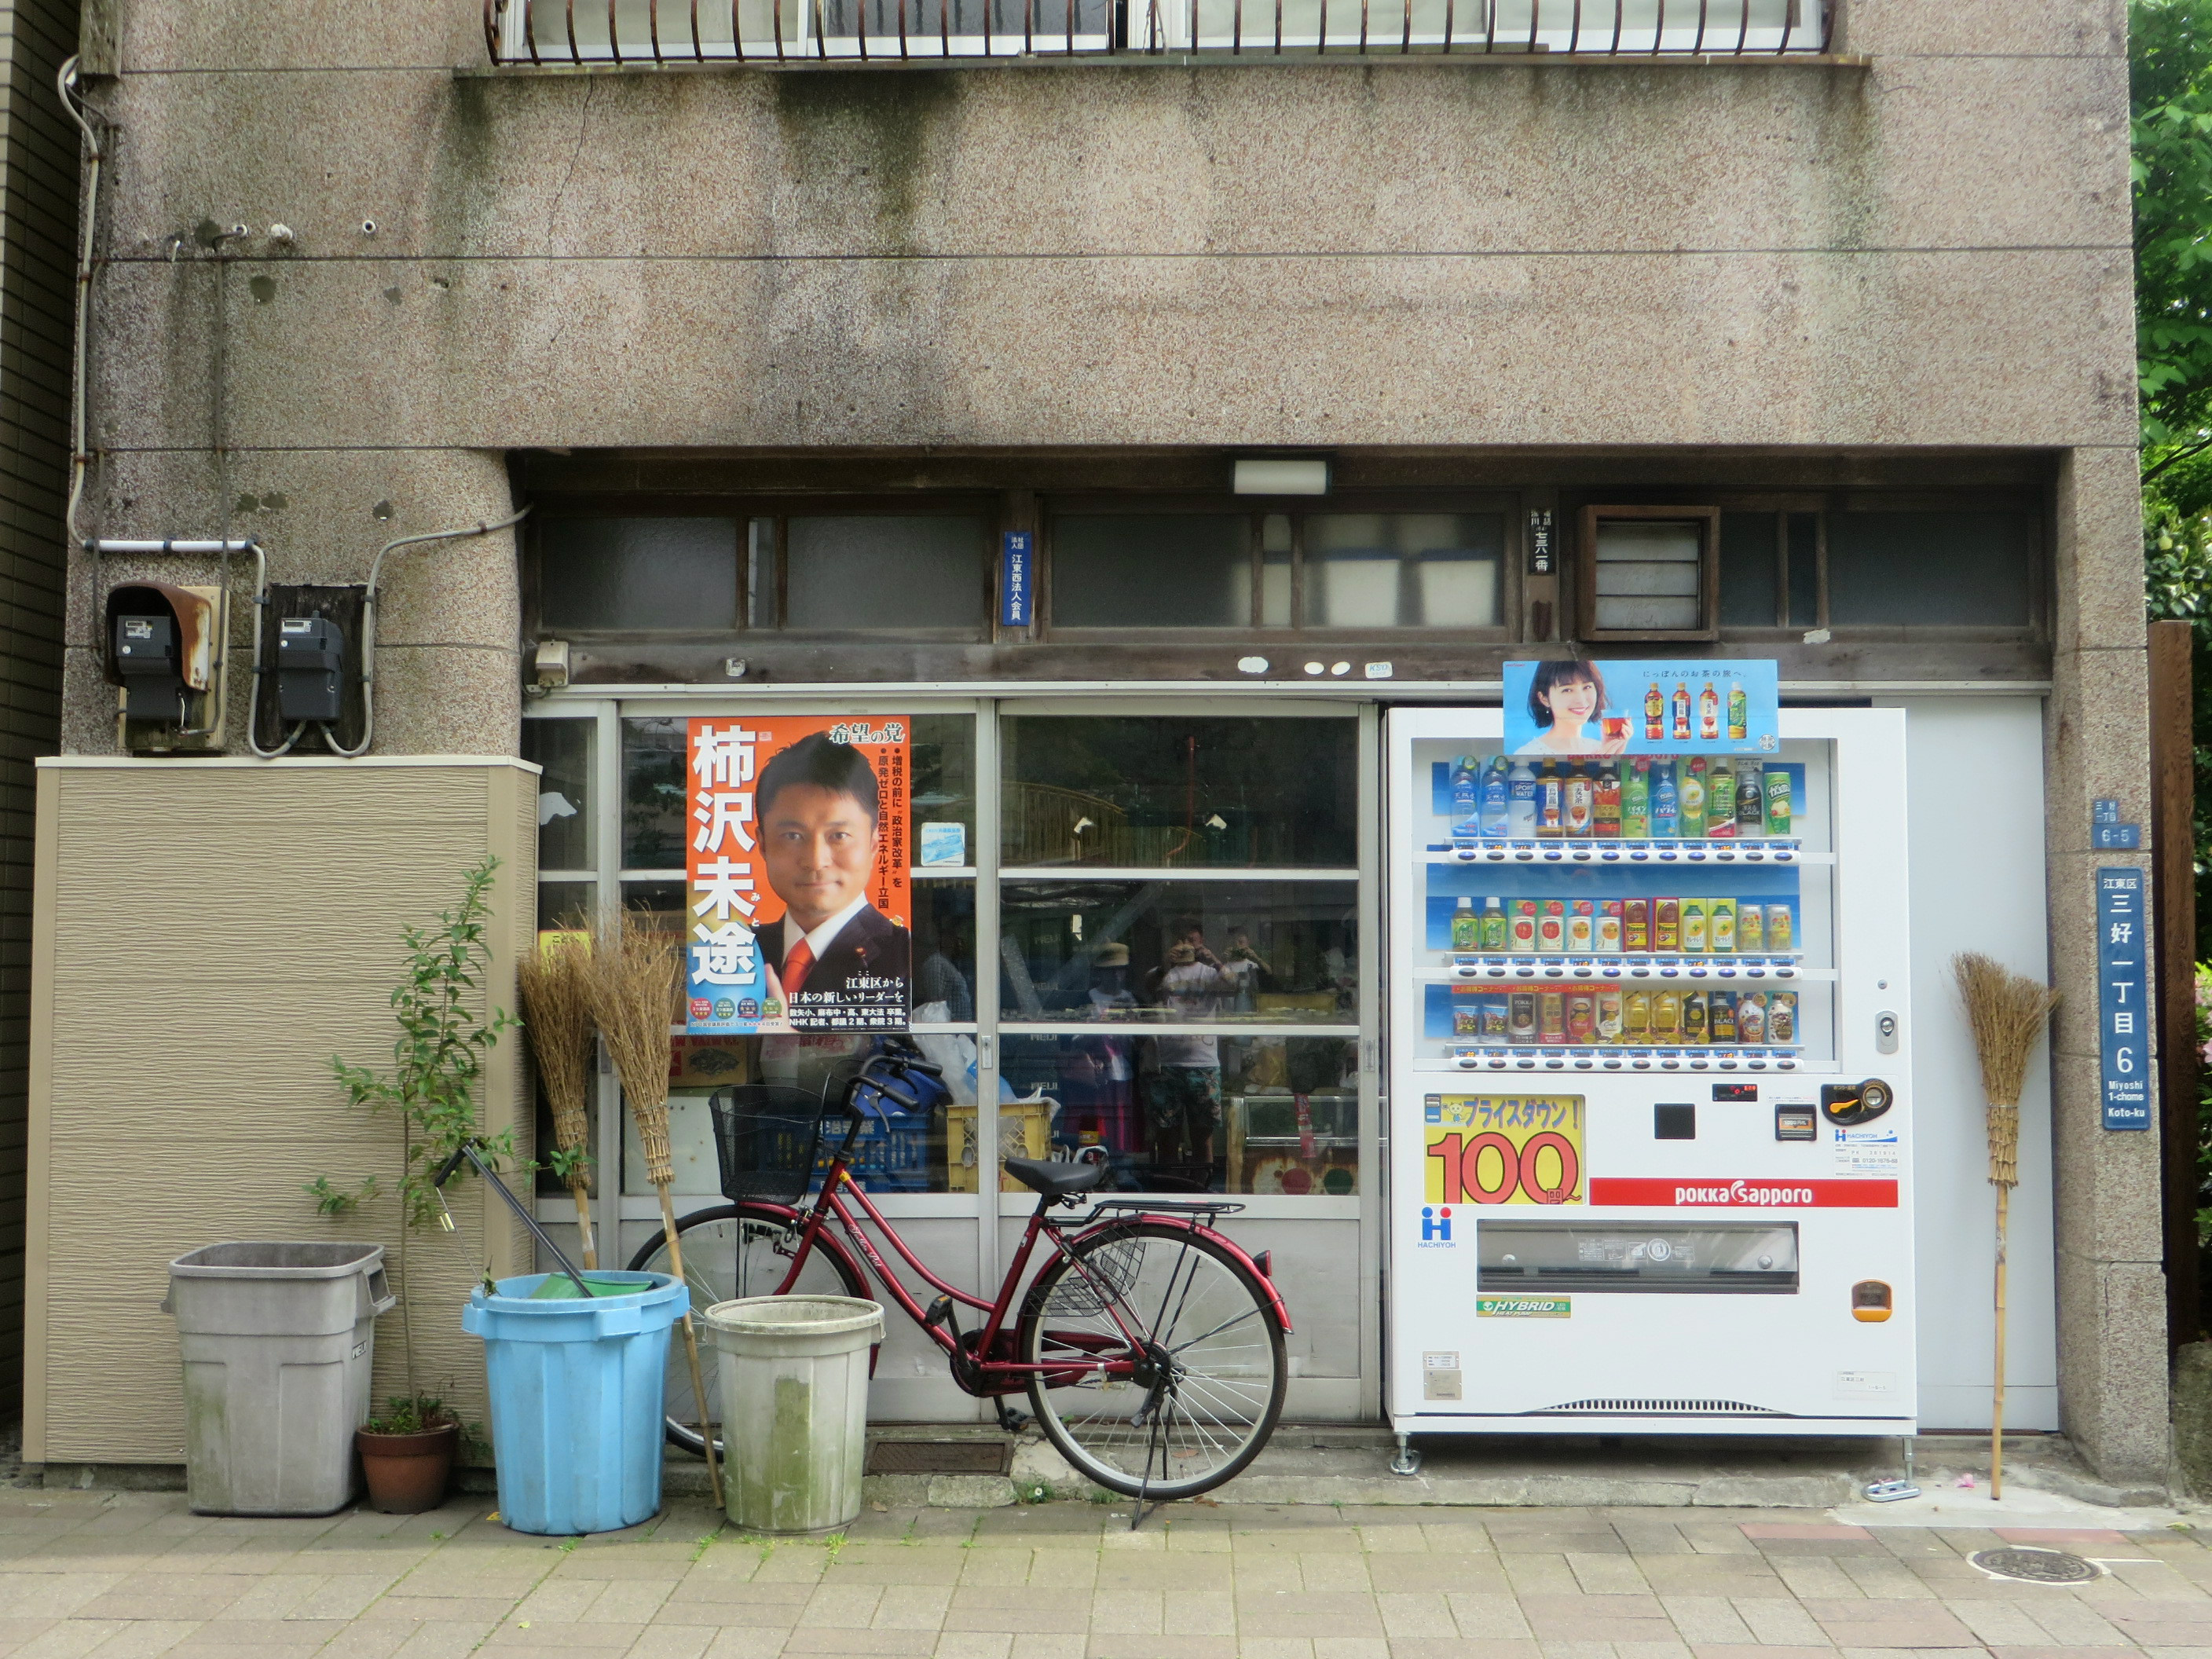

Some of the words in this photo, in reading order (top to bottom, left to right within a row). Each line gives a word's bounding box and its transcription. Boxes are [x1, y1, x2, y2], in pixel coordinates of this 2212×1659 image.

[1011, 554, 1023, 621] 江東西法人会員
[830, 722, 905, 745] 希望の党
[1575, 787, 1583, 804] 麦茶
[2096, 812, 2116, 822] 一丁目
[877, 755, 889, 909] 原発ゼロと自然エネルギー立国
[2101, 829, 2130, 842] 6-5
[692, 724, 756, 985] 柿沢未途
[2103, 878, 2137, 889] 江東区
[845, 976, 904, 989] 江東区から
[789, 991, 904, 1004] 日本の新しいリーダーを
[2108, 1080, 2143, 1090] Miyoshi
[2108, 1092, 2144, 1101] 1-chome
[2108, 1108, 2145, 1118] Koto-ku
[1675, 1187, 1730, 1205] pokka
[1738, 1187, 1813, 1206] sapporo
[1492, 1301, 1555, 1315] HYBRID
